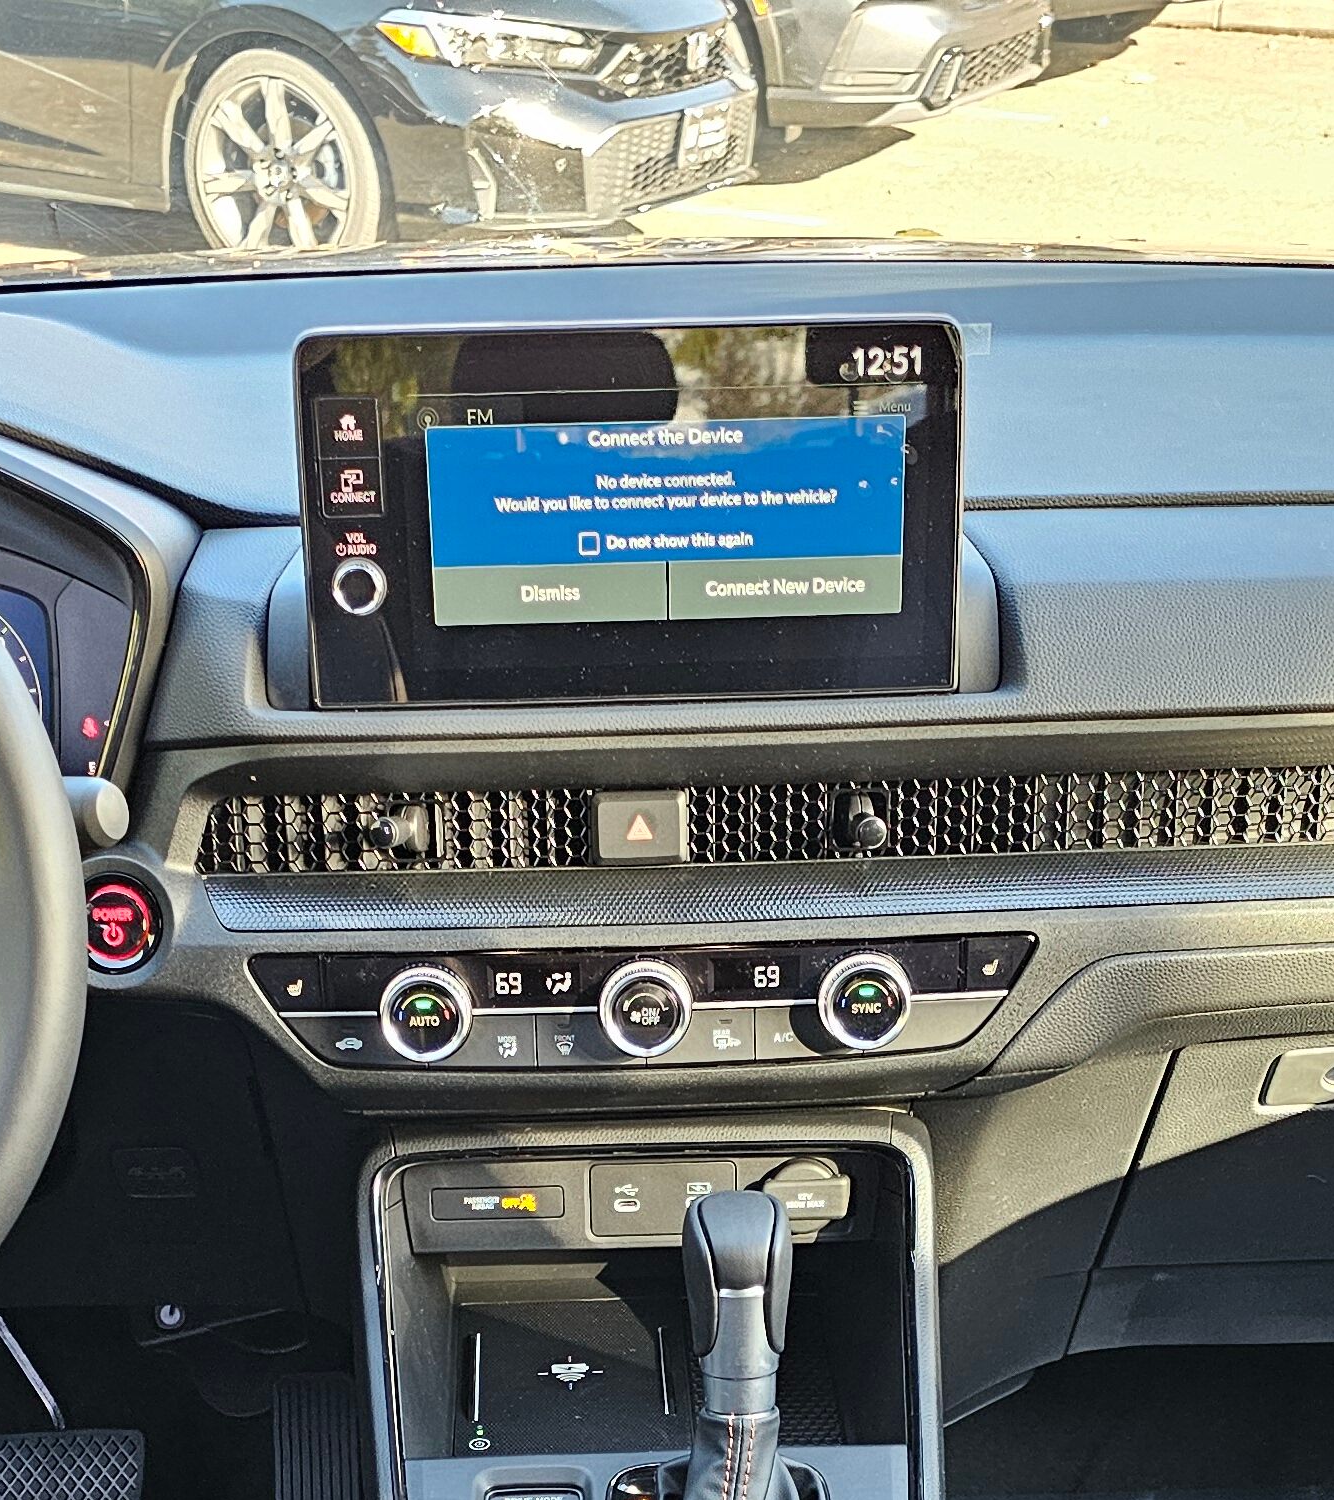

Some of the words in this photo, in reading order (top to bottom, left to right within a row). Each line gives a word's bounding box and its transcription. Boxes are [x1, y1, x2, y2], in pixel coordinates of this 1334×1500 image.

[852, 345, 923, 376] 12:51
[879, 401, 912, 414] Menu
[466, 408, 494, 426] FM
[334, 429, 364, 442] HOME
[587, 429, 655, 448] Connect
[657, 428, 685, 446] the
[687, 426, 744, 446] Device
[595, 473, 617, 491] No
[619, 473, 662, 490] device
[663, 470, 737, 489] connected.
[330, 490, 377, 504] CONNECT
[493, 495, 540, 514] Would
[541, 497, 567, 514] you
[568, 494, 593, 512] like
[594, 495, 610, 511] to
[611, 493, 665, 511] connect
[666, 494, 698, 512] your
[699, 491, 742, 508] device
[744, 491, 759, 507] to
[760, 489, 784, 506] the
[785, 487, 838, 506] vehicle?
[345, 532, 367, 545] VOL
[605, 534, 623, 551] Do
[628, 534, 652, 551] not
[653, 532, 689, 549] show
[691, 532, 718, 548] this
[718, 532, 754, 550] again
[347, 543, 377, 556] AUDIO
[521, 584, 580, 603] Dismiss
[705, 578, 771, 598] Connect
[773, 577, 809, 596] New
[812, 576, 866, 595] Device
[92, 907, 133, 921] POWER
[496, 972, 522, 995] 69
[754, 965, 781, 988] 69
[851, 1003, 882, 1015] SYNC
[409, 1015, 440, 1028] AUTO
[773, 1032, 794, 1043] A/C
